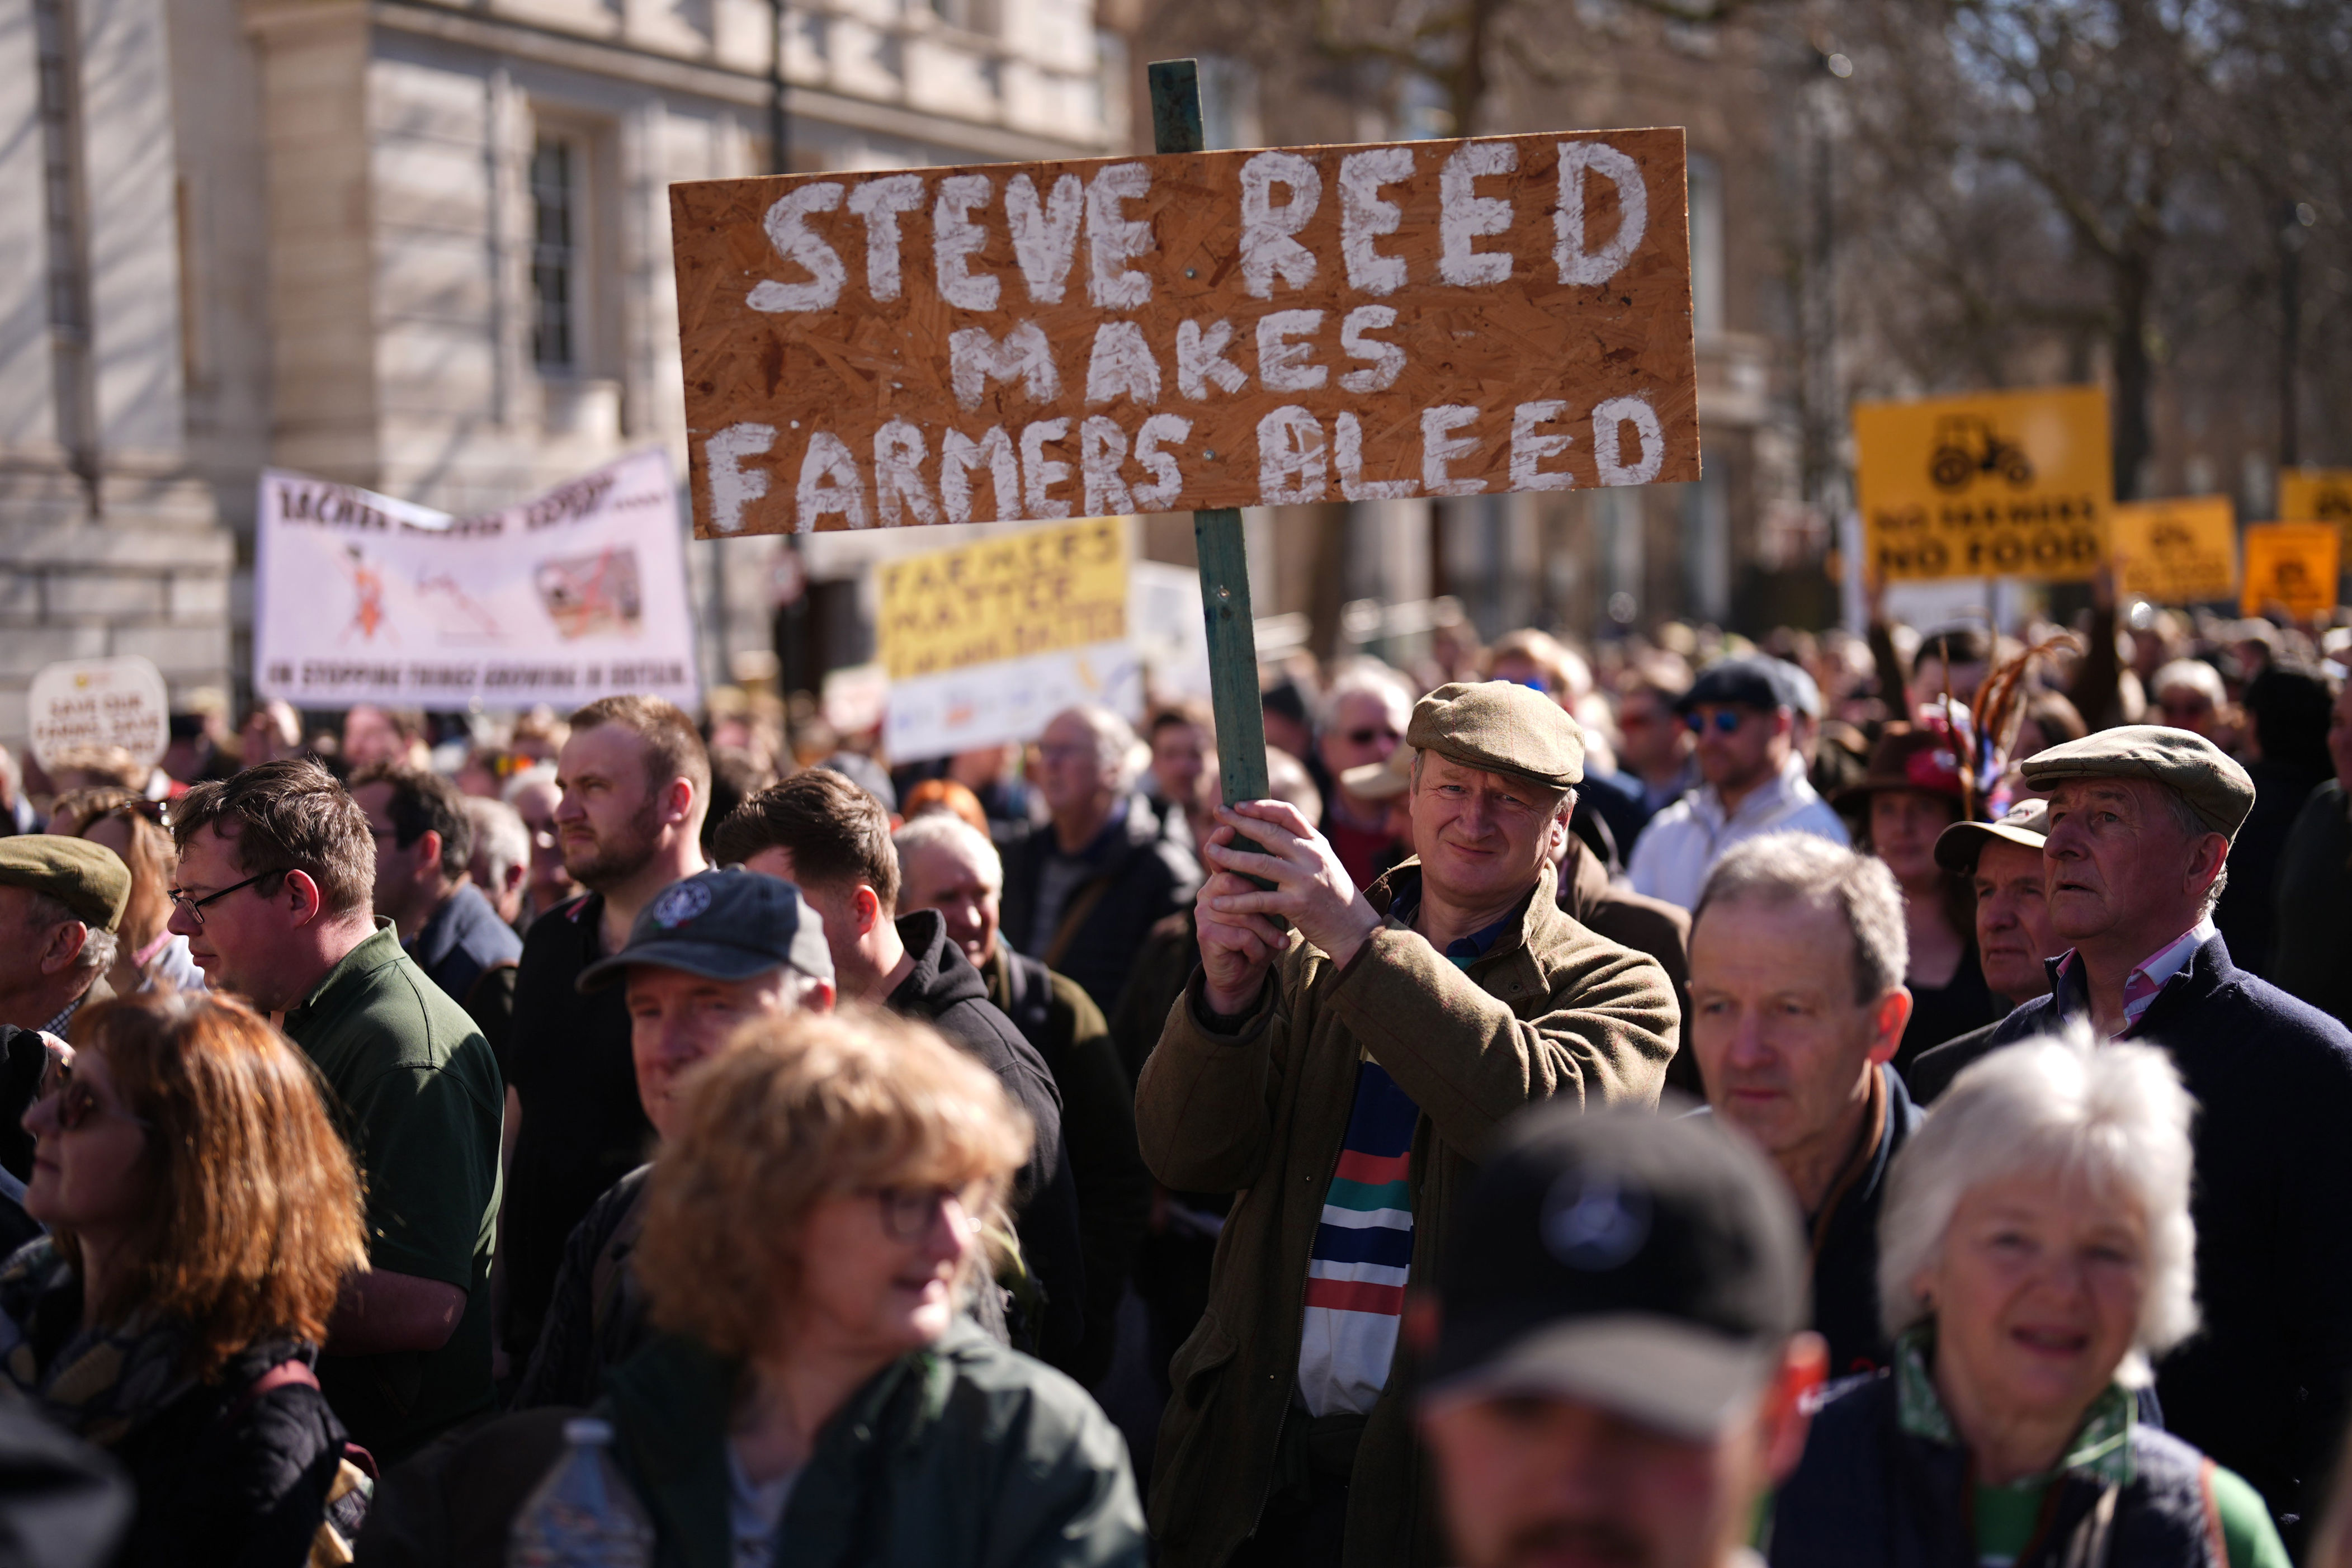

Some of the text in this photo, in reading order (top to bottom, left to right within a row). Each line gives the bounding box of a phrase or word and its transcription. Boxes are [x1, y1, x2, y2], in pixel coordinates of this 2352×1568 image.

[746, 140, 1647, 313] STEVE REED
[949, 305, 1406, 410] MAKES
[706, 395, 1664, 533] FARMERS BLEED
[1879, 526, 2101, 575] NO FOOD
